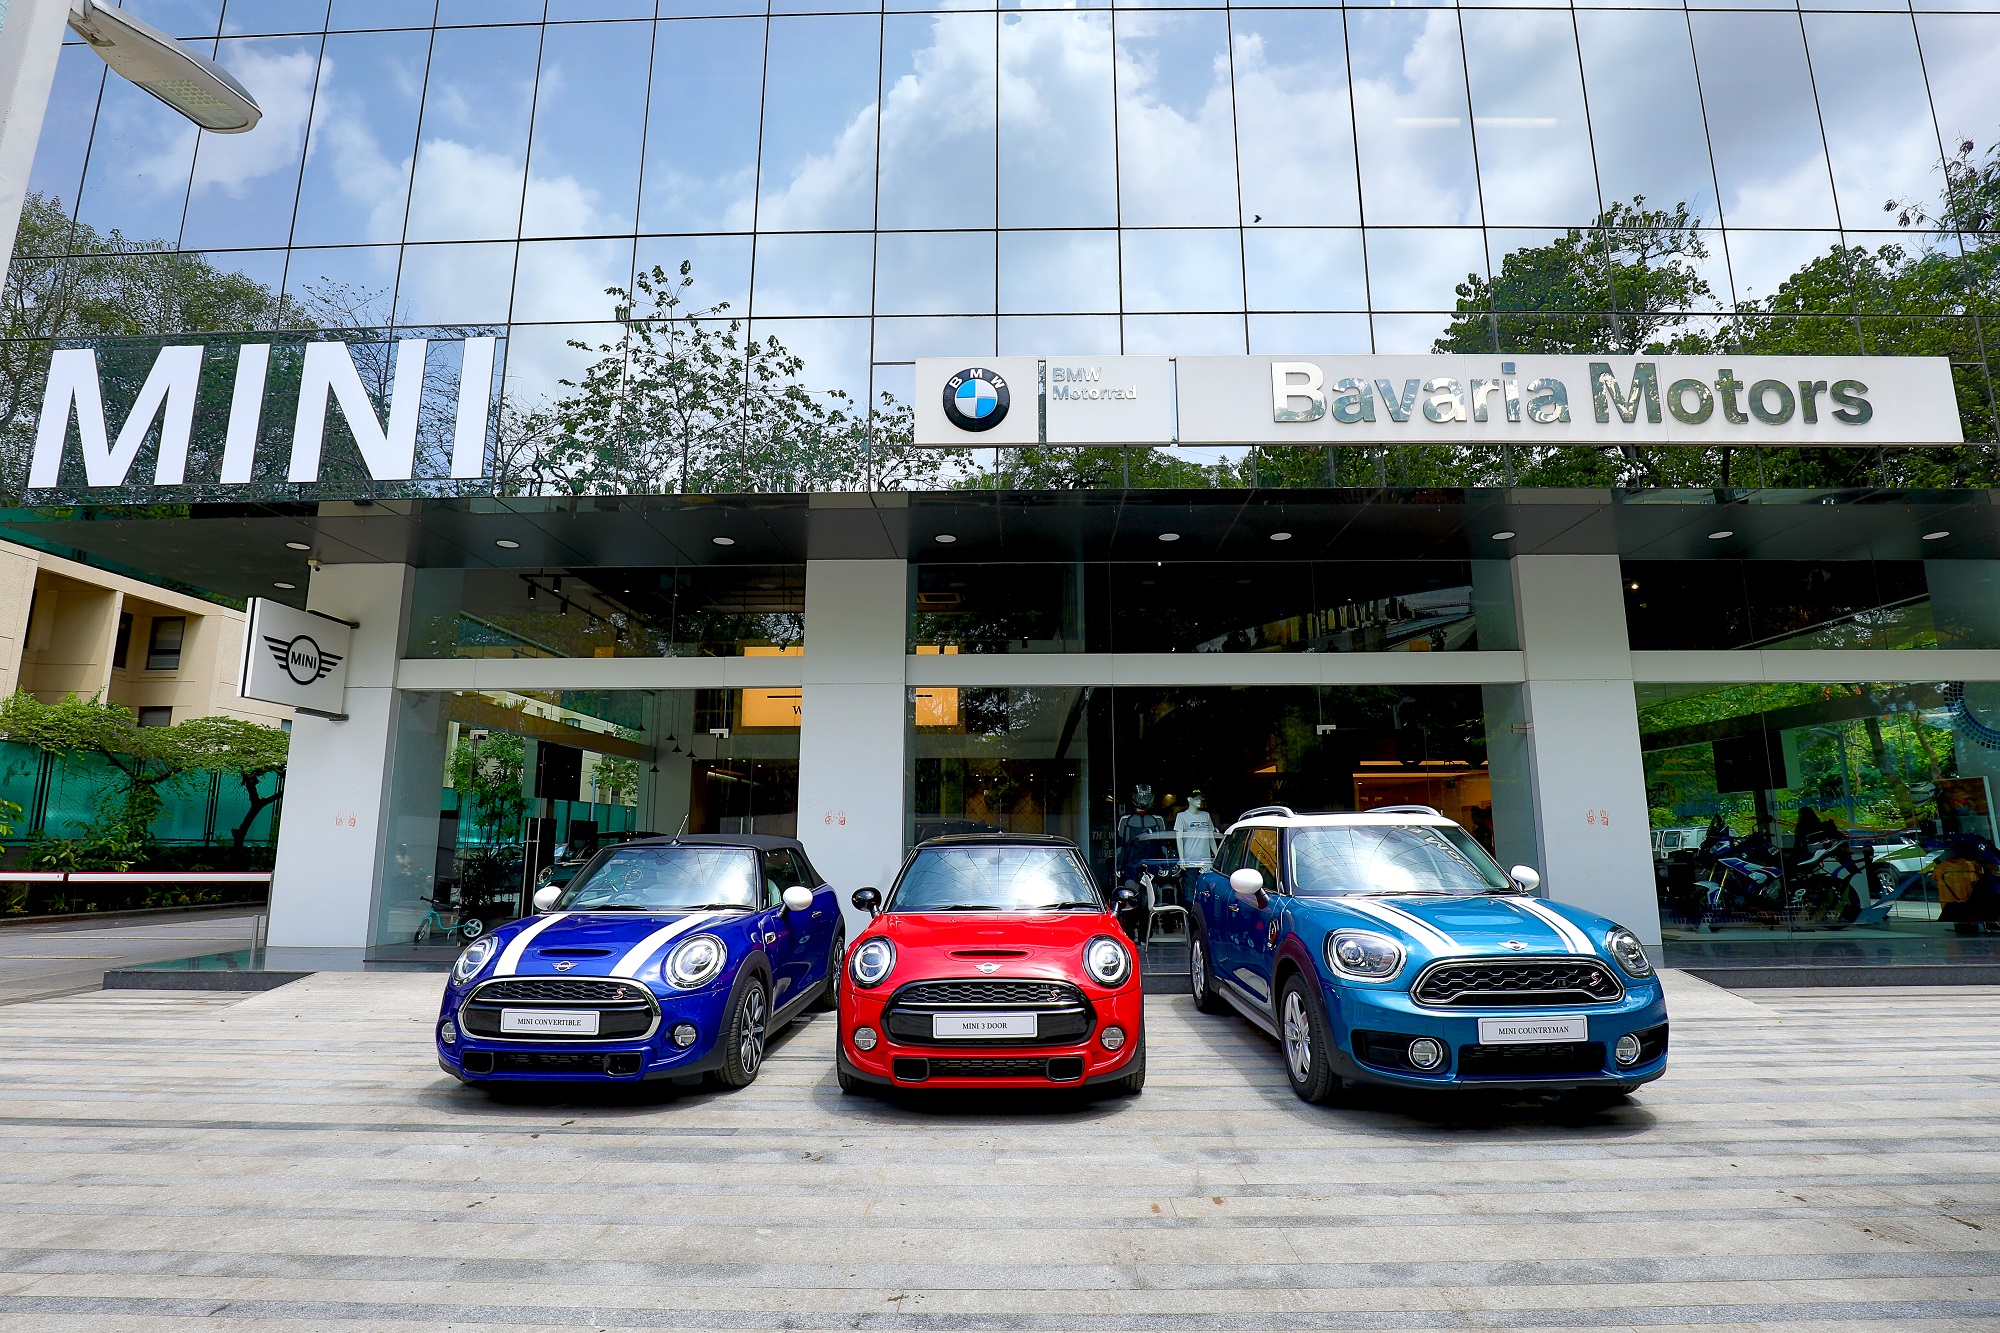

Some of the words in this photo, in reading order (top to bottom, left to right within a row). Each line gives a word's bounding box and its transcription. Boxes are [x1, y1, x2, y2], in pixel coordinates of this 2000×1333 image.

[949, 368, 1005, 390] BMW
[1052, 367, 1102, 382] BMW
[1052, 384, 1137, 401] Motorrad
[1270, 360, 1571, 425] Bavaria
[1589, 362, 1874, 426] Motors
[28, 337, 497, 488] MINI
[290, 650, 317, 670] MINI
[534, 1018, 582, 1027] CONVERTIBLE
[962, 1022, 979, 1030] MINI
[1498, 1027, 1516, 1035] MINI
[1518, 1026, 1570, 1034] COUNTRYMAN
